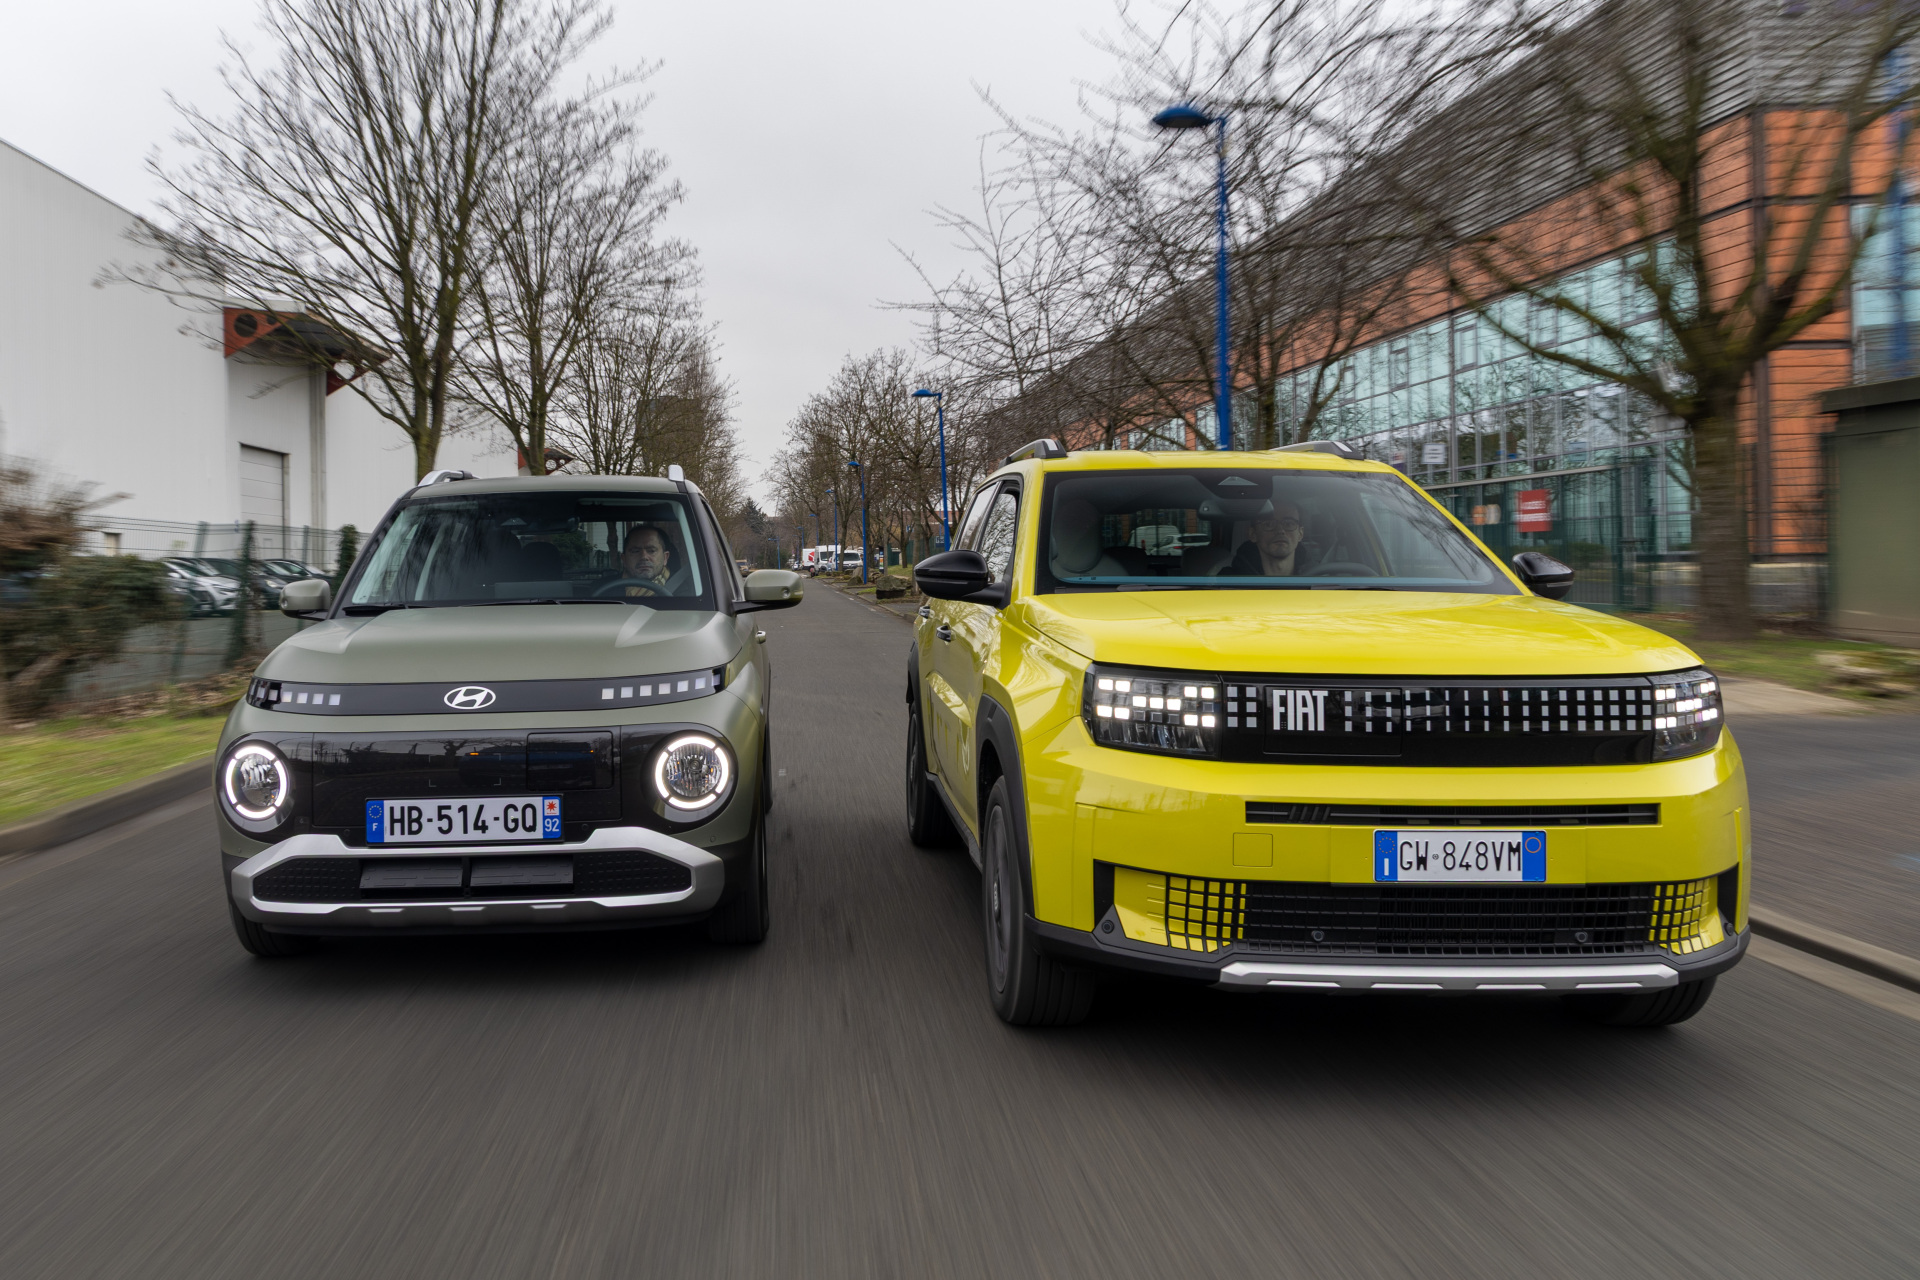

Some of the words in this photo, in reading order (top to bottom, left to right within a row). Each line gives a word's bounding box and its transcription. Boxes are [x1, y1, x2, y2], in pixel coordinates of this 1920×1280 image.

[1272, 689, 1329, 732] FIAT
[372, 822, 378, 831] F
[389, 803, 538, 836] HB-514-GQ
[544, 818, 560, 832] 92
